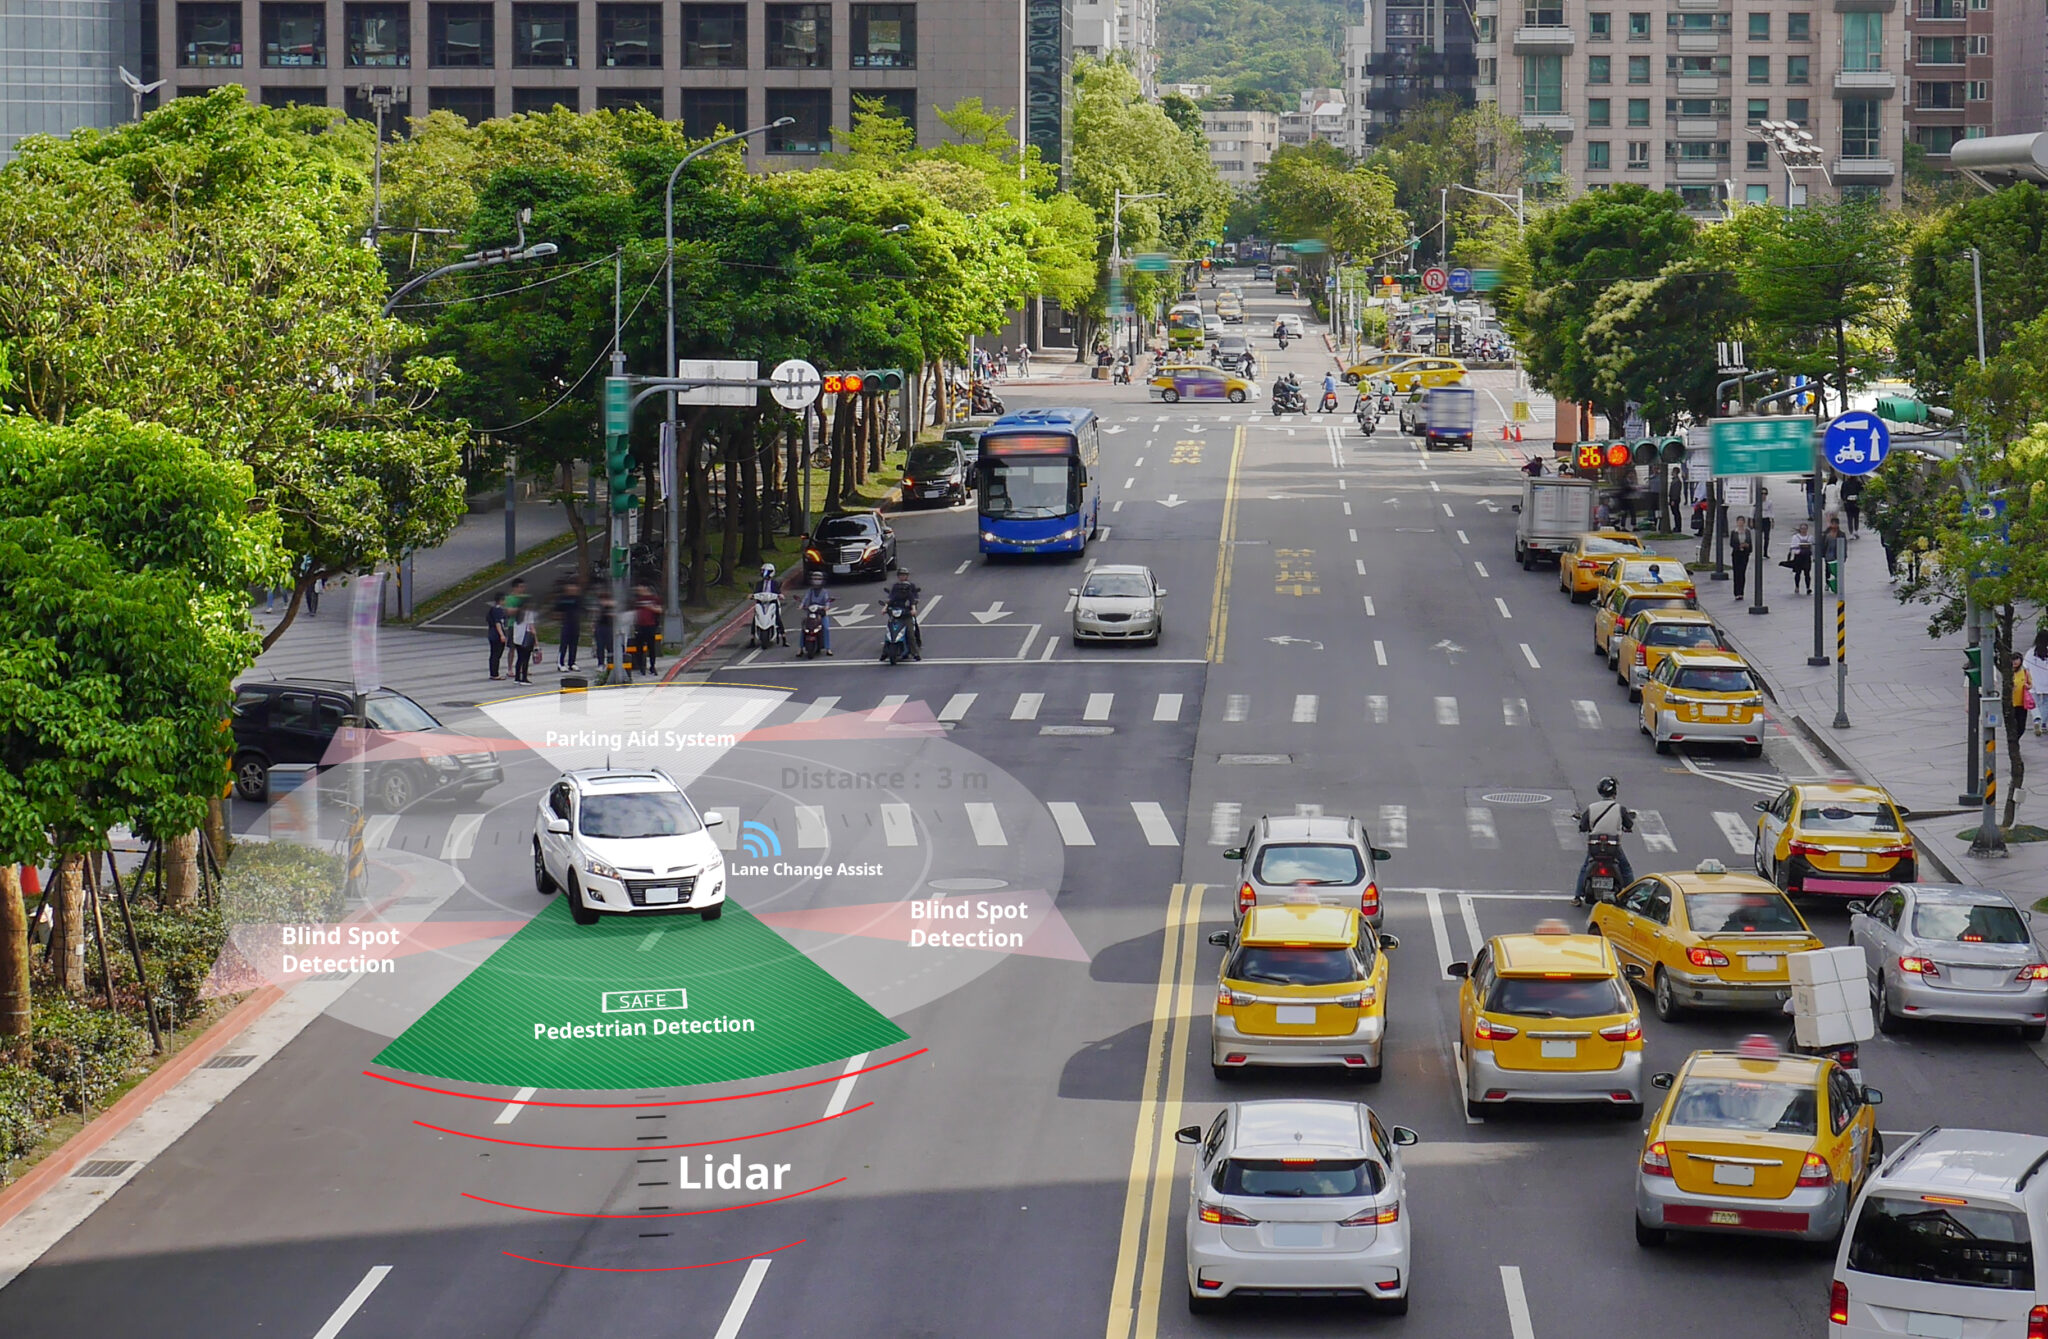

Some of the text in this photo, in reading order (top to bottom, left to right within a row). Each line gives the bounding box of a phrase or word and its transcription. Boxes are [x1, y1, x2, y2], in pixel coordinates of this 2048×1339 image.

[824, 376, 842, 392] 26
[1578, 445, 1602, 468] 26
[1713, 1211, 1738, 1224] TAXI
